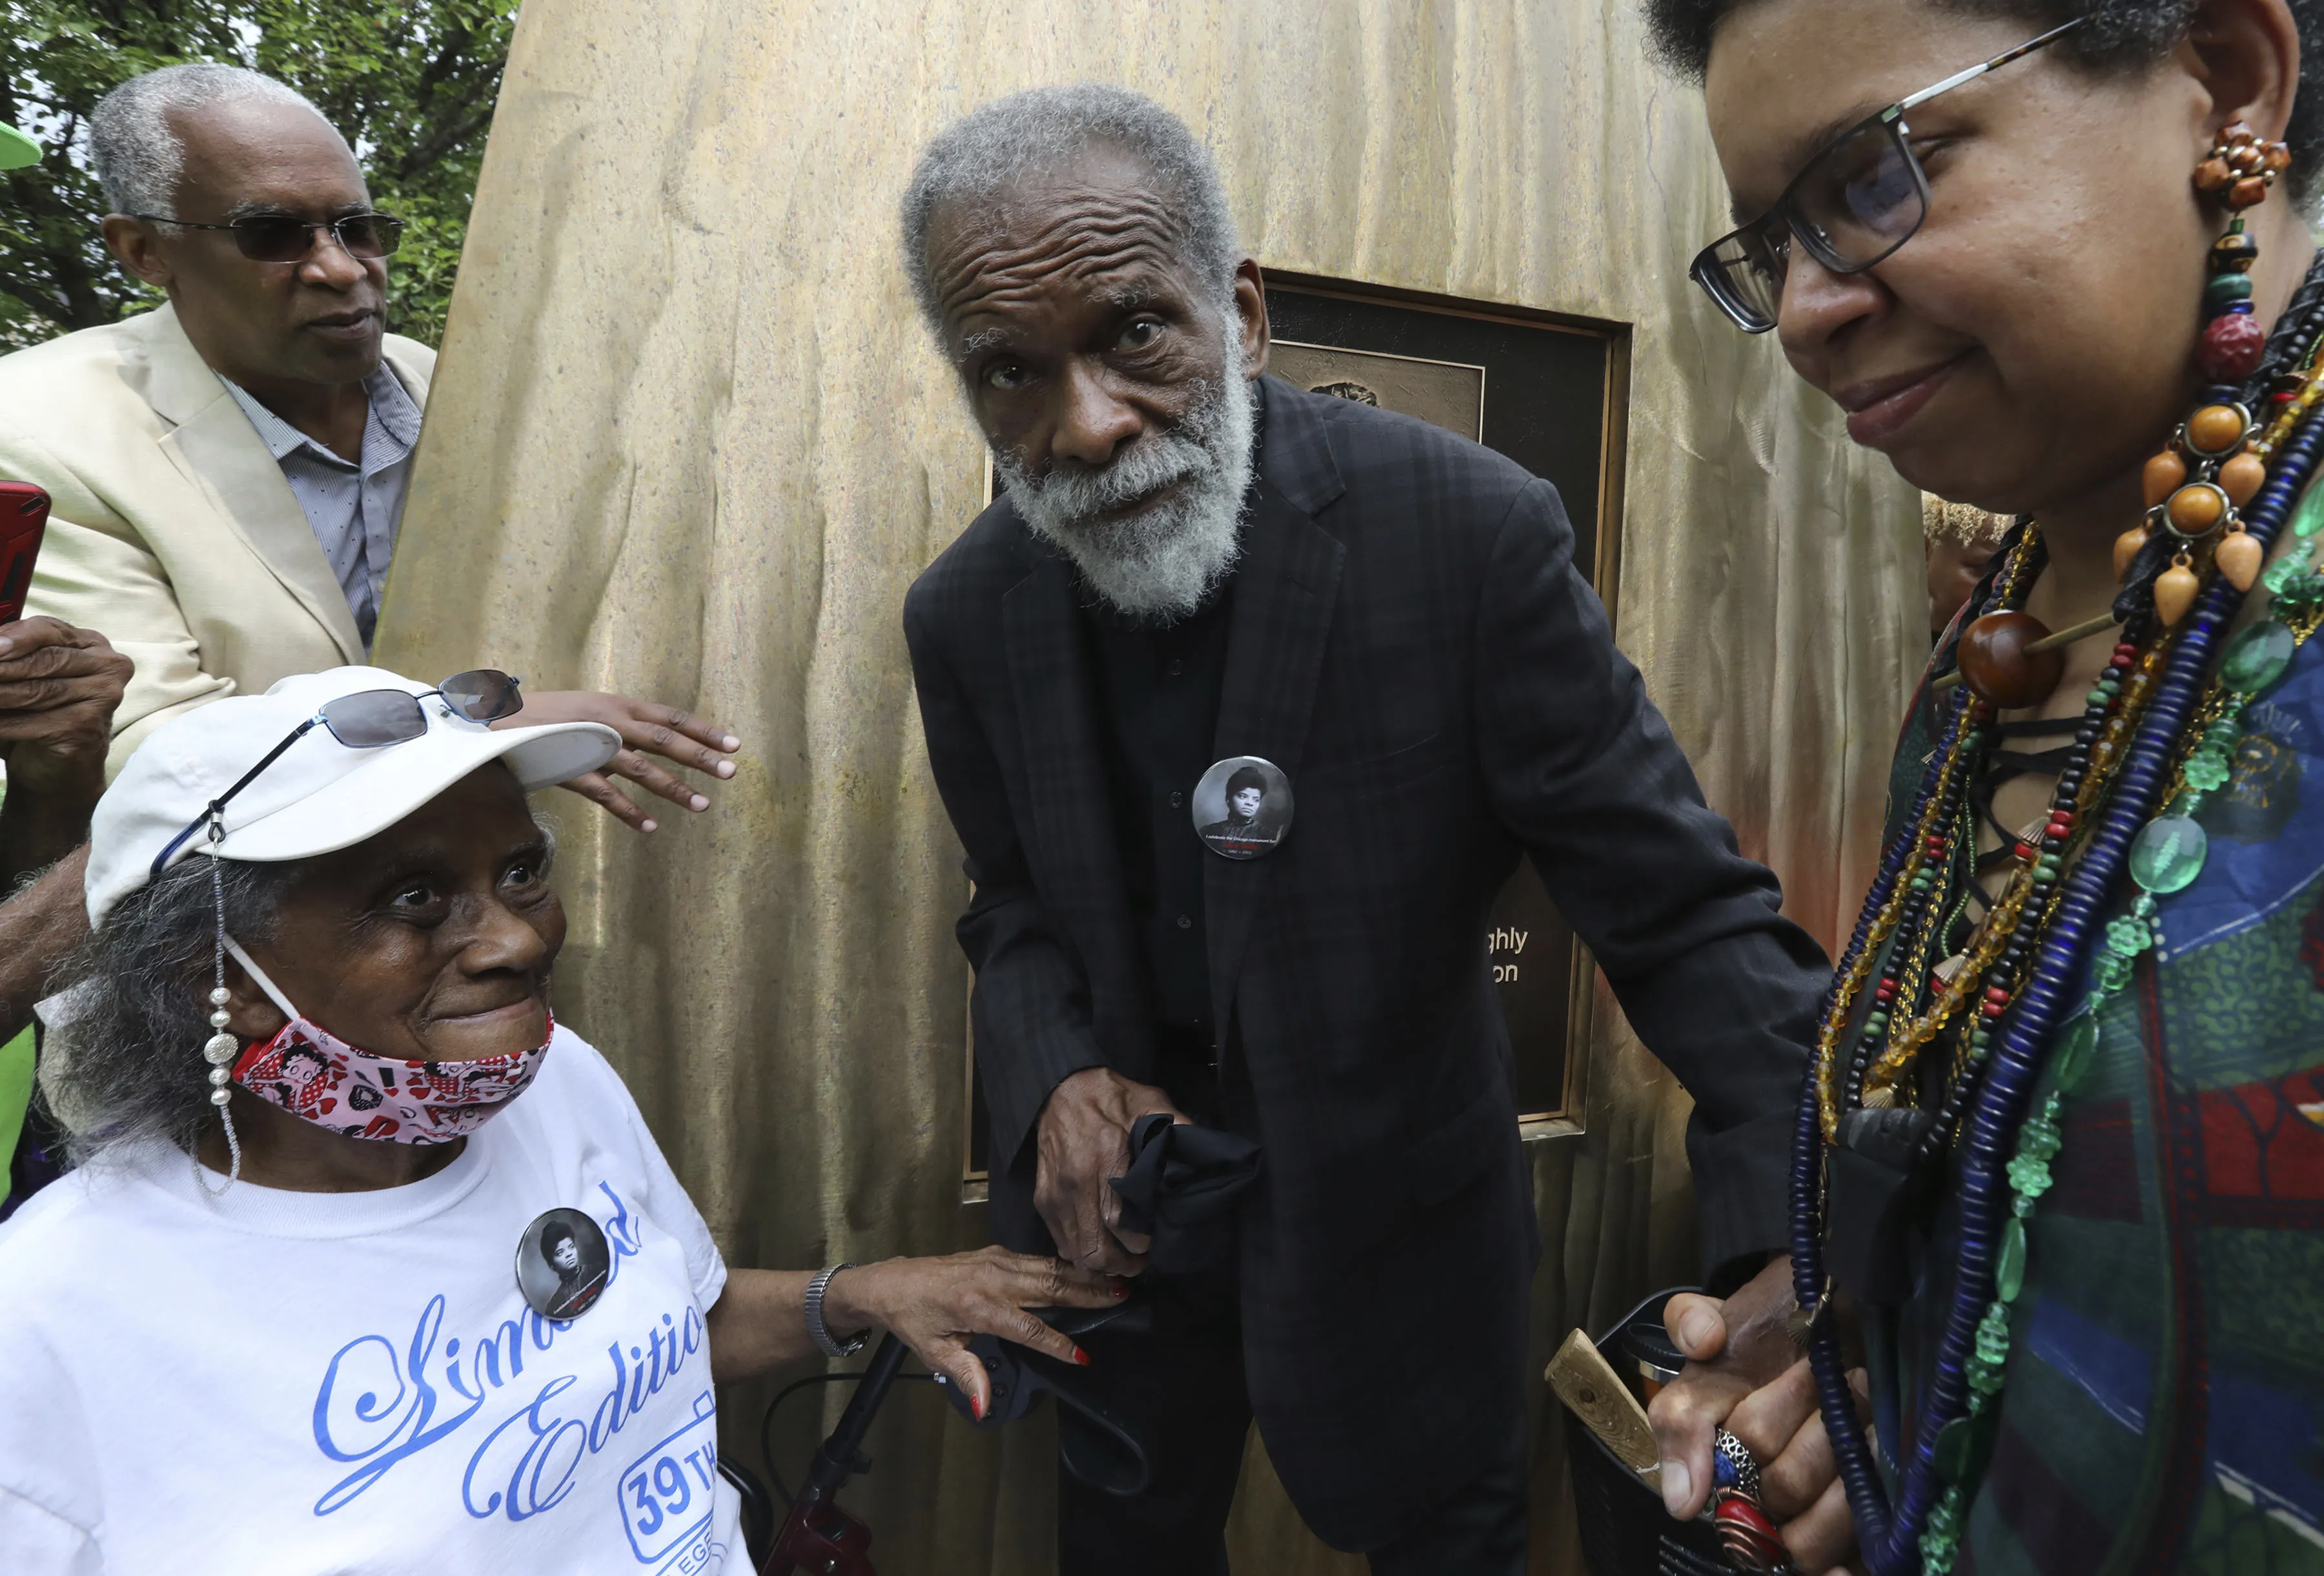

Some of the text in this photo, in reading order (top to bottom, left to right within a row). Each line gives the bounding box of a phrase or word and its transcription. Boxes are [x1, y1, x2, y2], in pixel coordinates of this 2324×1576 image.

[313, 1180, 642, 1517] Limd
[462, 1298, 706, 1522] Editio
[627, 1440, 716, 1536] 39TH
